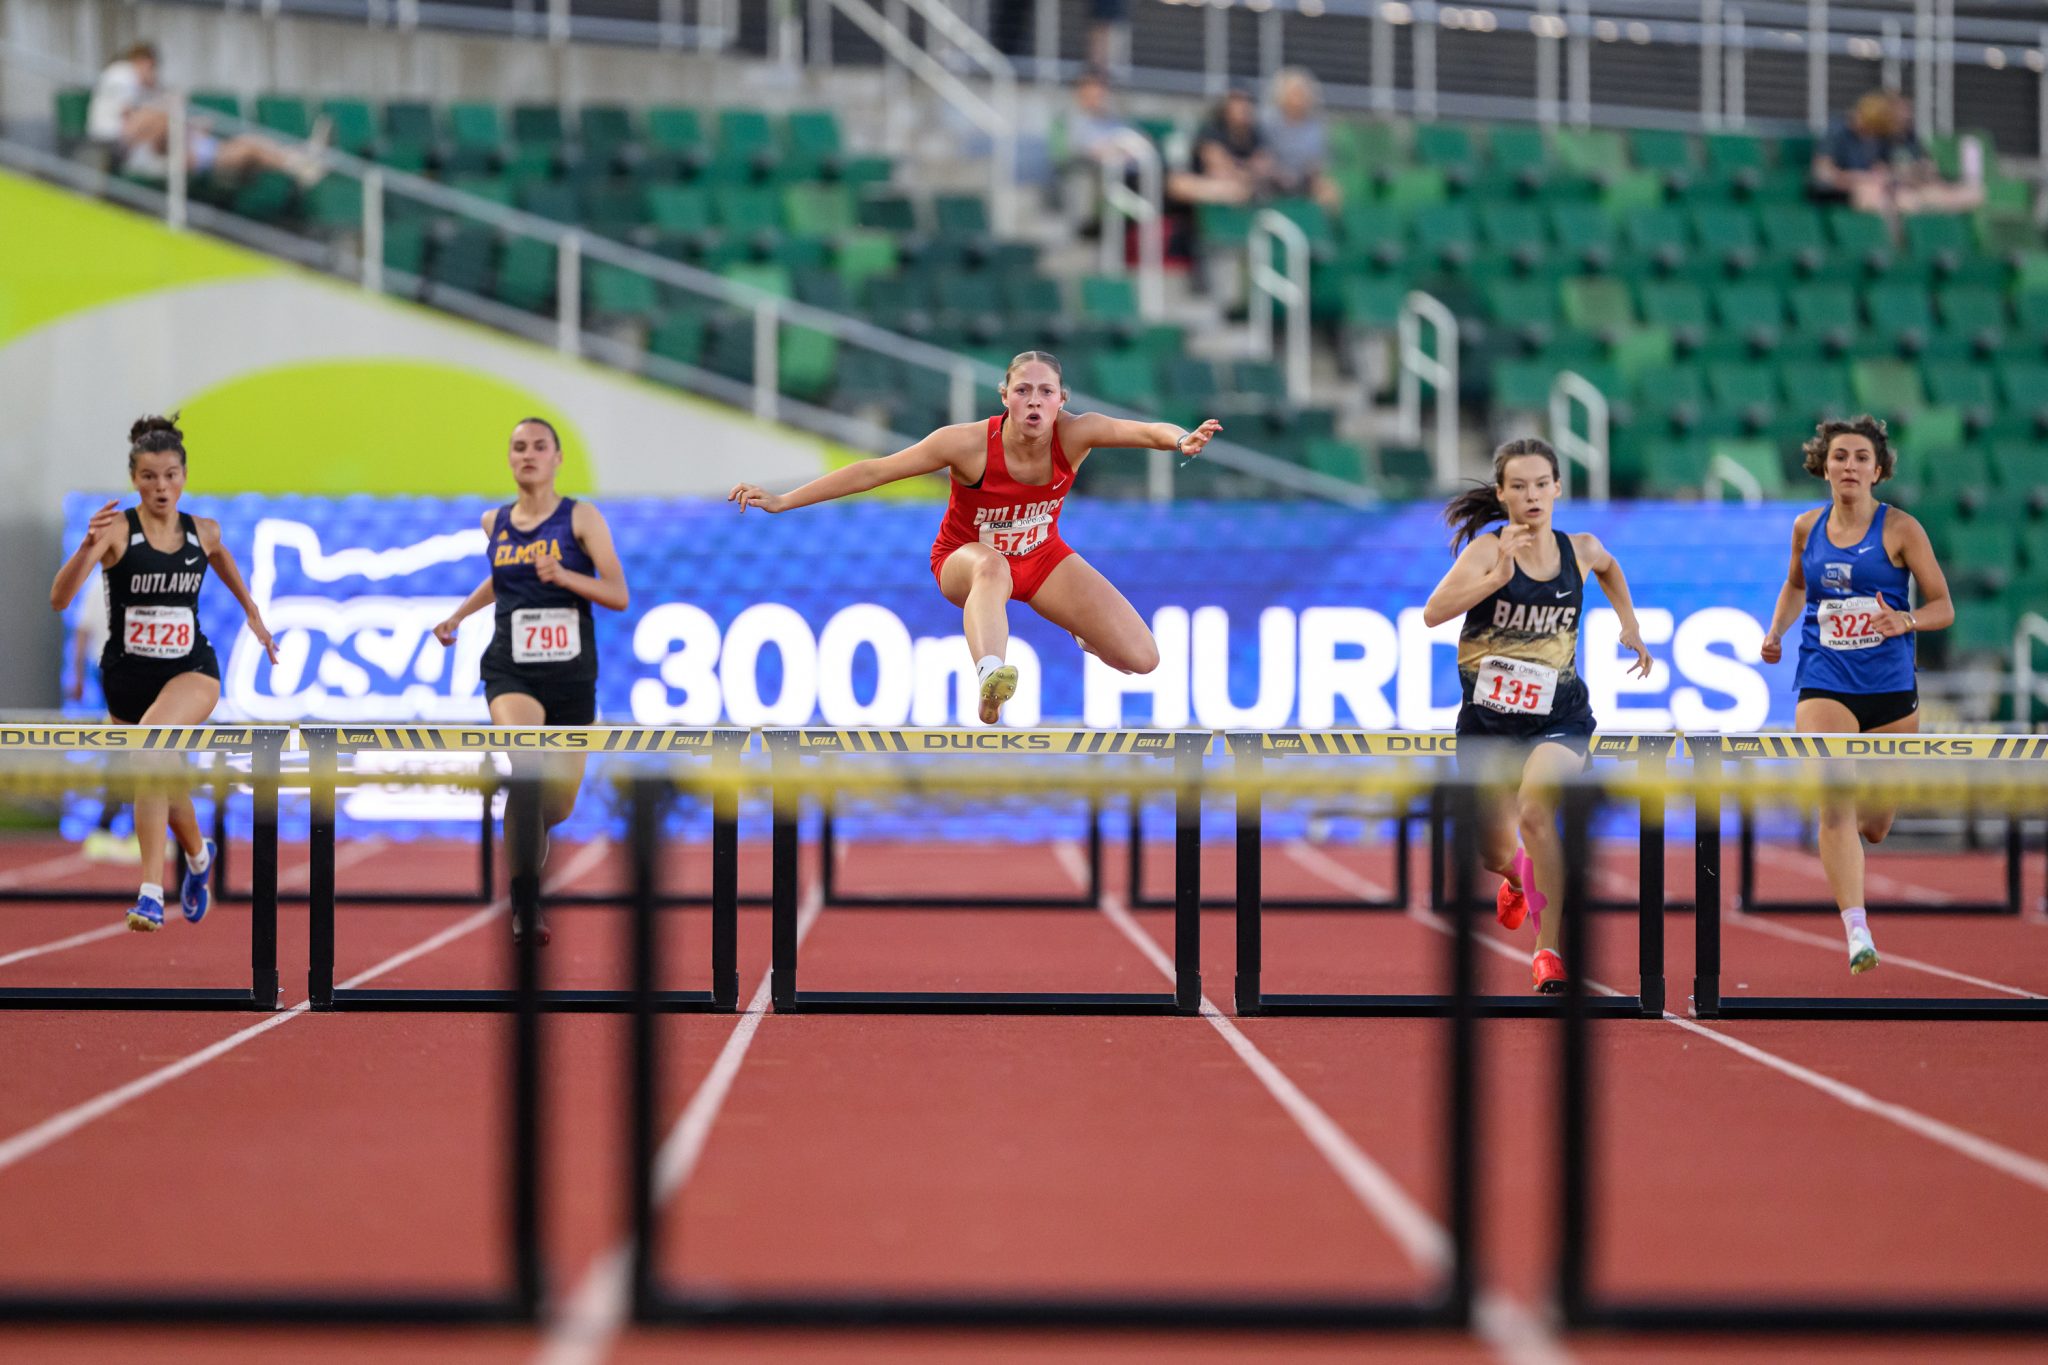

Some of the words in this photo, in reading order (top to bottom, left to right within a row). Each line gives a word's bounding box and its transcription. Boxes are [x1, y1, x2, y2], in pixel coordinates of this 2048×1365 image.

[994, 526, 1039, 552] 579
[130, 572, 201, 593] OUTLAWS
[1492, 599, 1577, 634] BANKS
[1829, 612, 1875, 638] 322
[129, 621, 190, 646] 2128
[525, 625, 568, 649] 790
[630, 602, 1041, 728] 300m
[1083, 605, 1770, 732] HURDES
[1488, 675, 1542, 710] 135
[1, 731, 128, 746] DUCKS
[214, 734, 240, 744] GILL
[349, 734, 375, 744] GILL
[461, 732, 588, 747] DUCKS
[675, 736, 700, 745] GILL
[812, 736, 837, 746] GILL
[923, 734, 1050, 749] DUCKS
[1137, 738, 1163, 747] GILL
[1274, 739, 1300, 748] GILL
[1386, 736, 1457, 751] DUC
[1600, 741, 1626, 750] GILL
[1734, 742, 1760, 751] GILL
[1846, 741, 1973, 755] DUCKS
